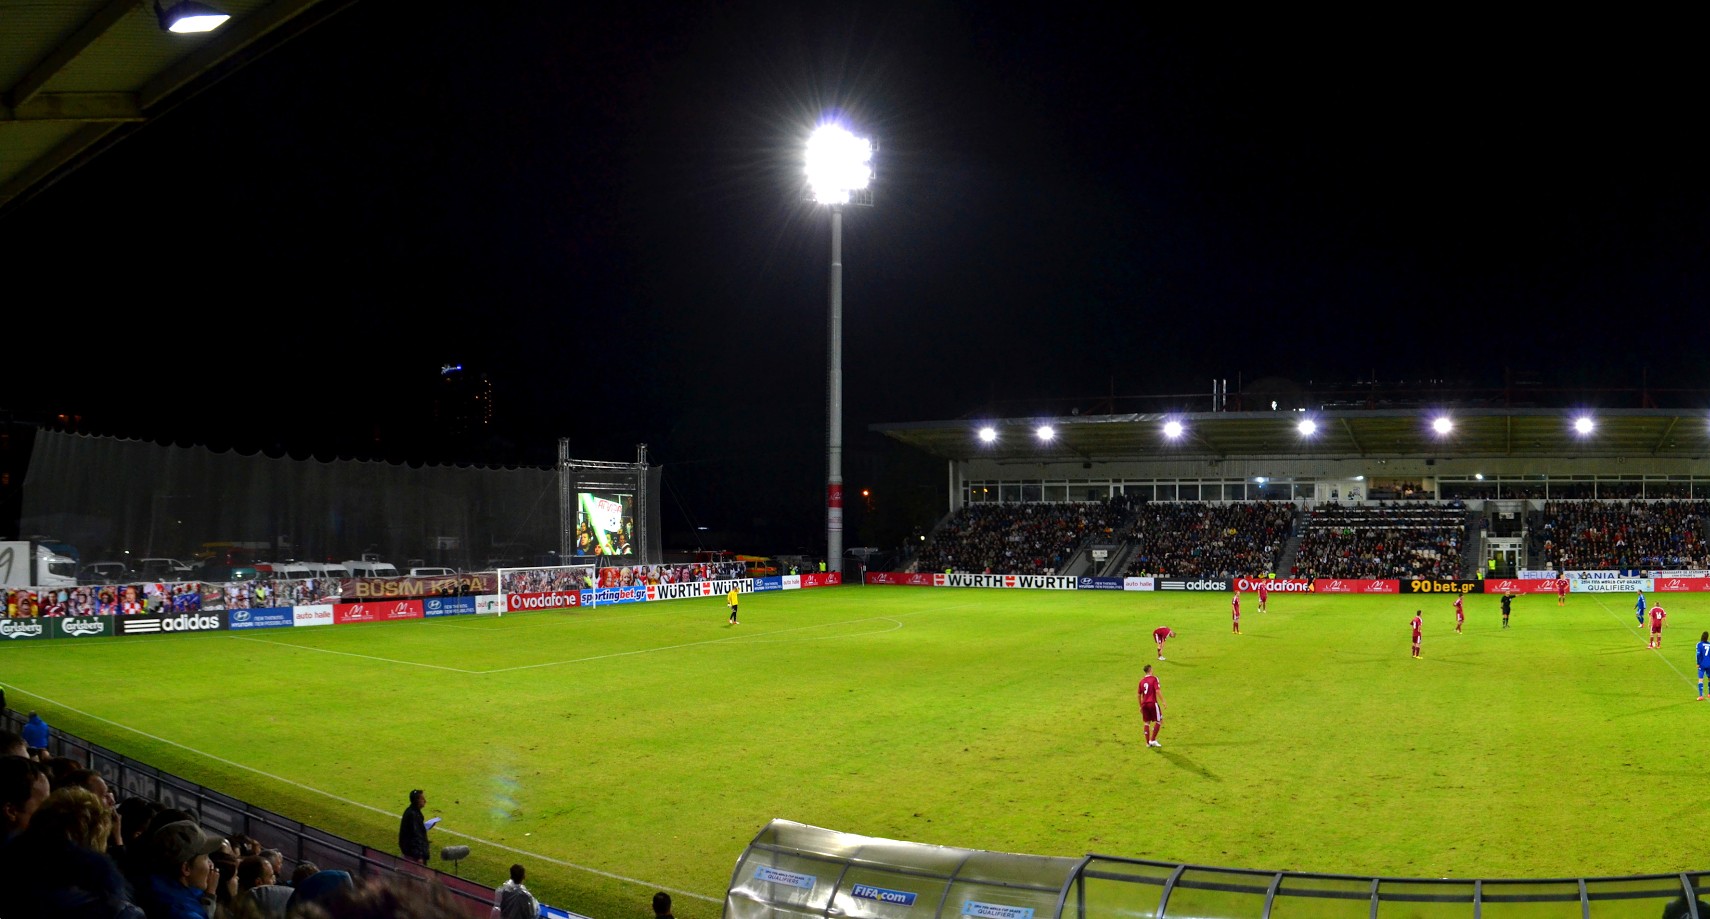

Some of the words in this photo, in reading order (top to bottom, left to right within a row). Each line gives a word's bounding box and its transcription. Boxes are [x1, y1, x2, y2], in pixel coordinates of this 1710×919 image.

[1186, 579, 1226, 591] adidas
[523, 592, 576, 609] vodafone
[296, 612, 313, 620] auto
[314, 610, 331, 619] halle
[62, 617, 104, 635] Carlsberg
[162, 614, 220, 631] adidas
[1704, 646, 1709, 656] 7
[767, 874, 799, 885] QUALIFIERS
[854, 885, 906, 903] FIFA.com
[977, 909, 1015, 918] QUALIFIERS
